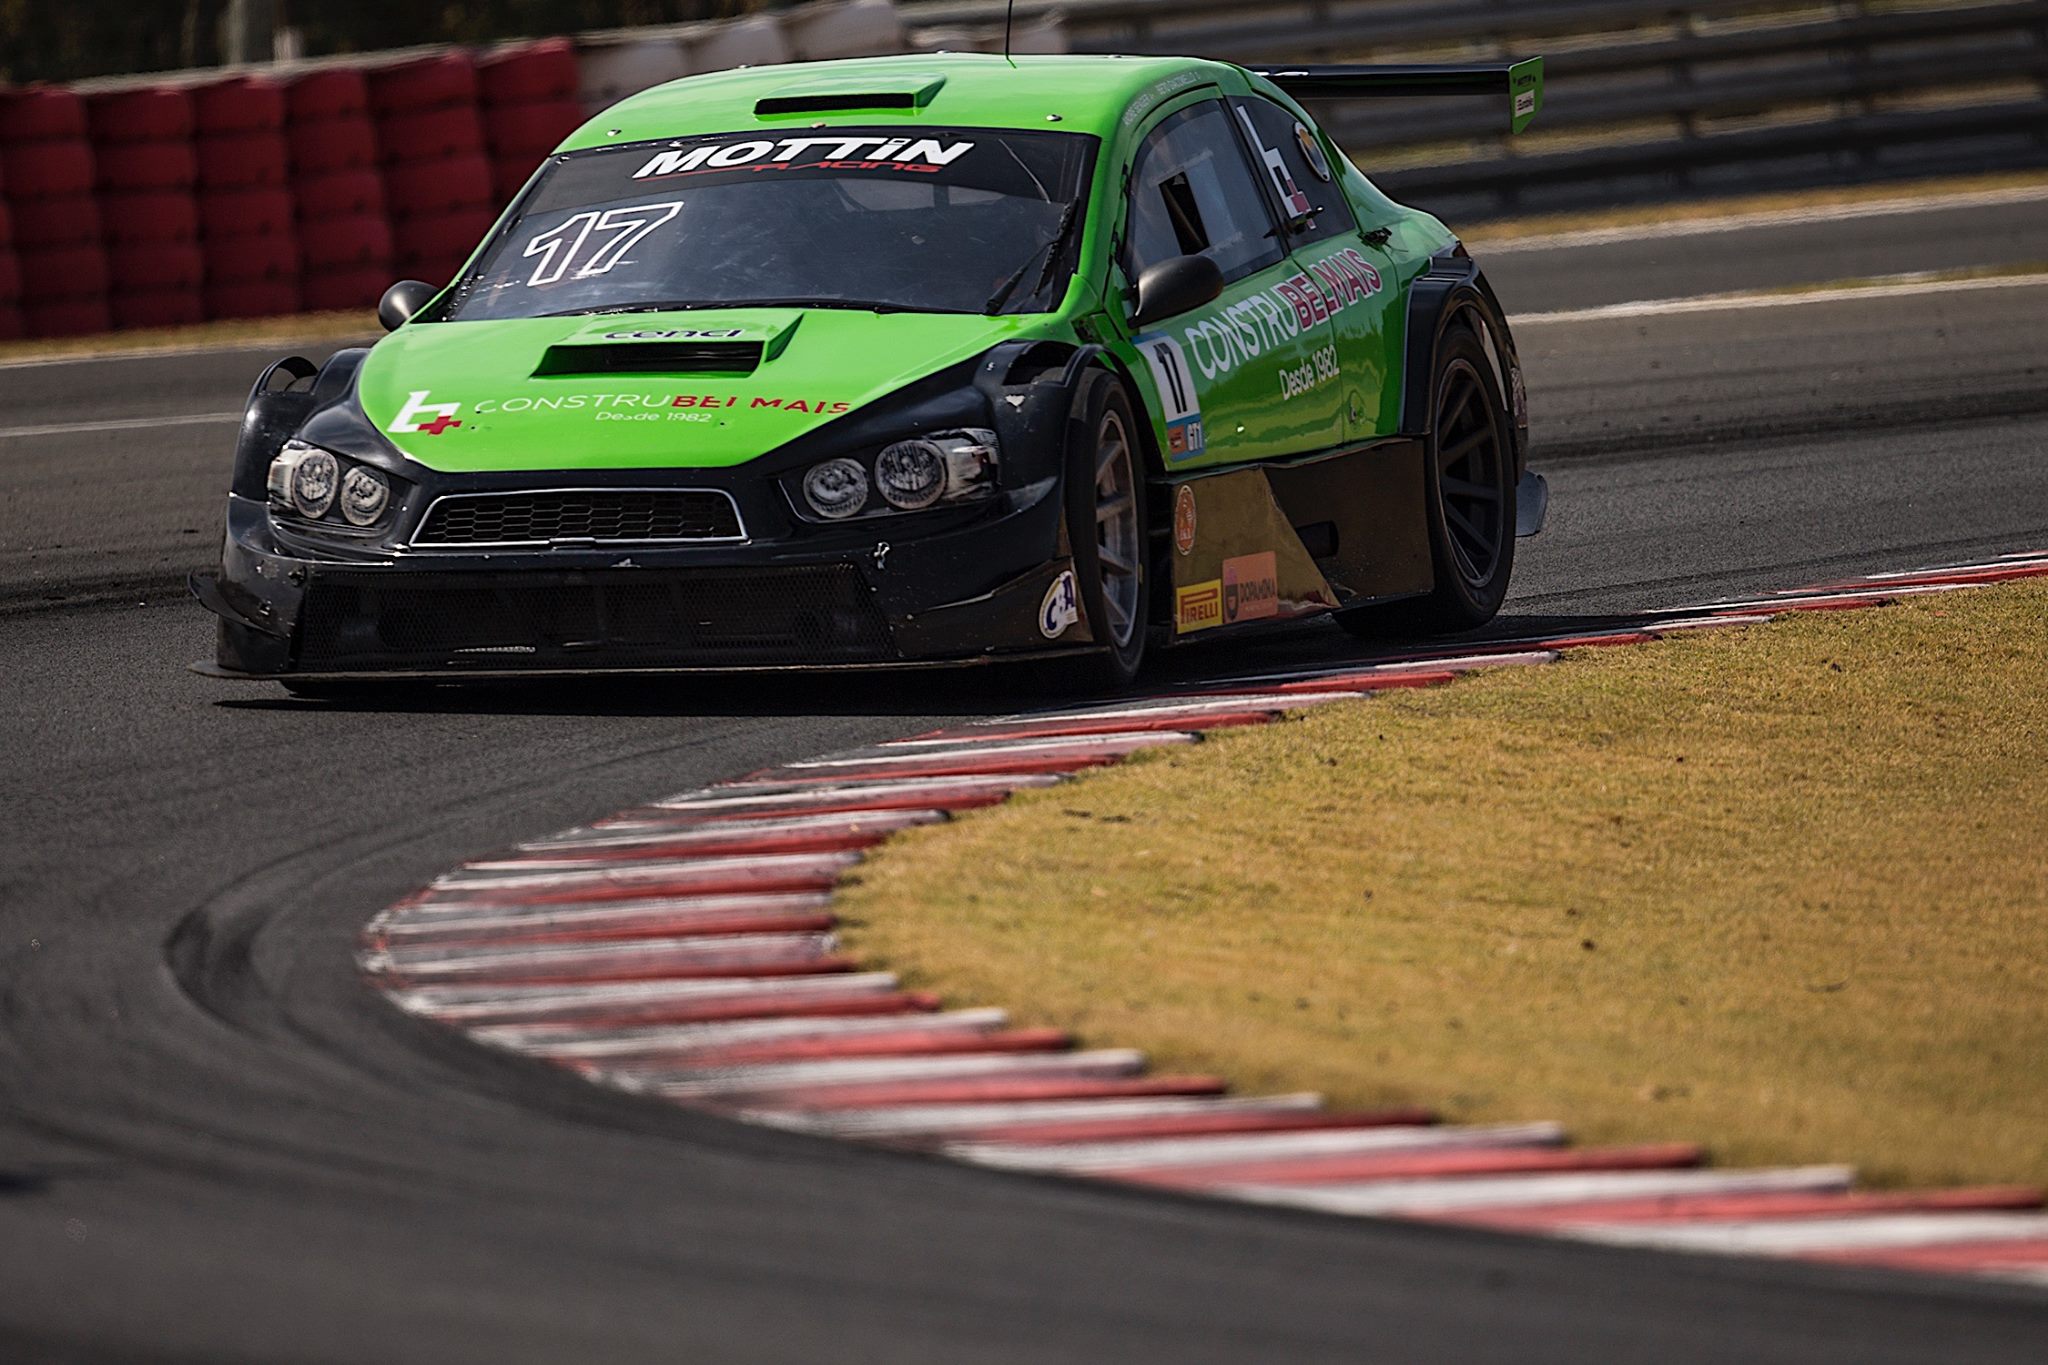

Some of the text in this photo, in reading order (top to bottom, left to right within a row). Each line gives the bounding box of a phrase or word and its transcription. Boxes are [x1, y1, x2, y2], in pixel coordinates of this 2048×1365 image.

[522, 200, 685, 288] 17
[1308, 247, 1383, 307] MAIS
[1278, 343, 1341, 401] Desde 1982
[595, 411, 713, 423] Desde 1982
[750, 396, 851, 415] MAIS
[1180, 587, 1219, 625] PIRELLI
